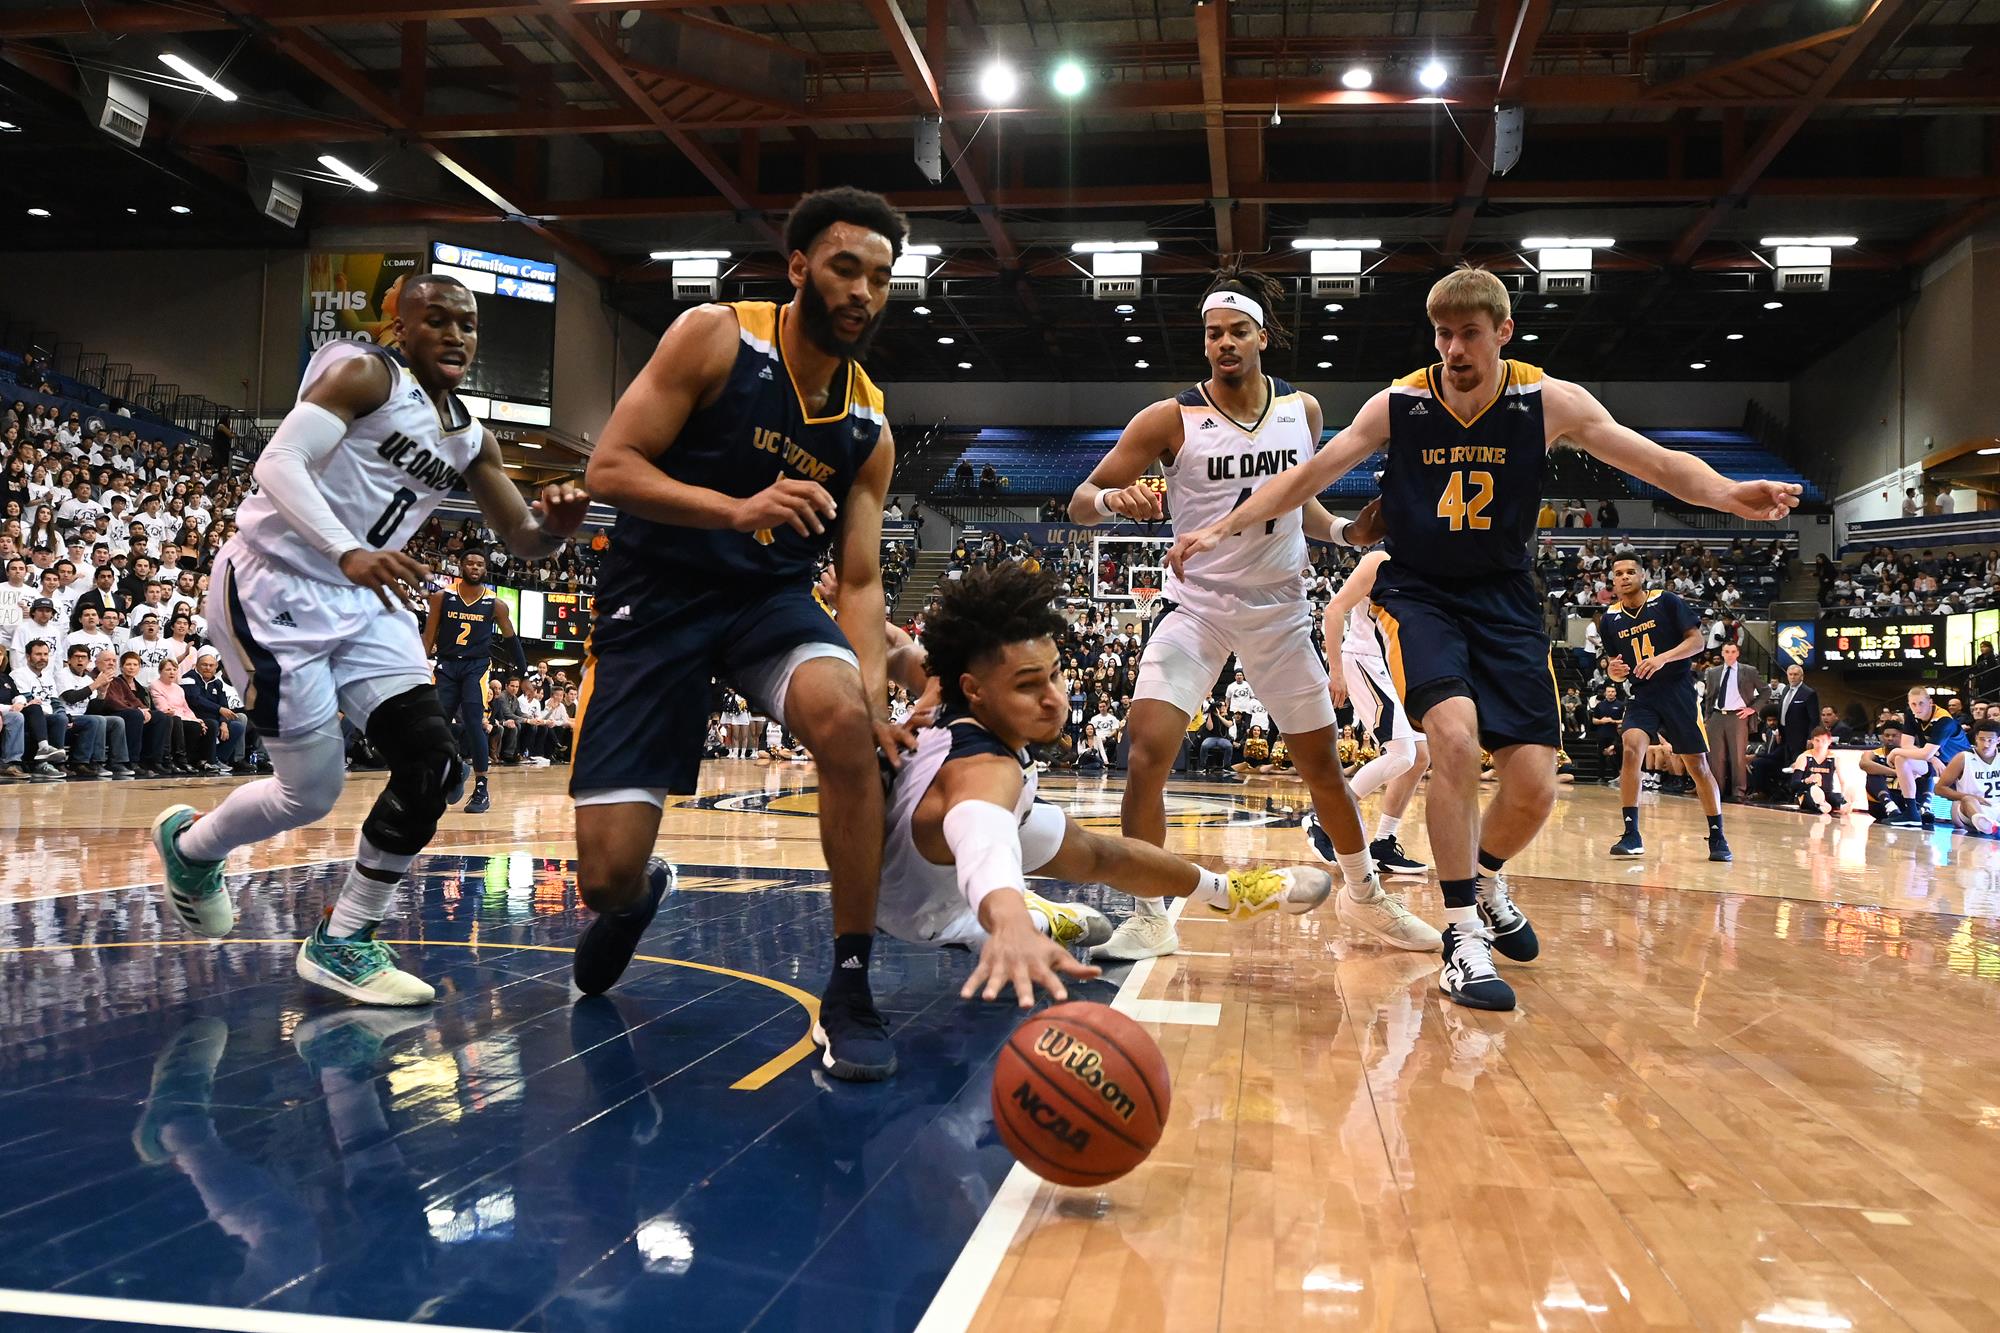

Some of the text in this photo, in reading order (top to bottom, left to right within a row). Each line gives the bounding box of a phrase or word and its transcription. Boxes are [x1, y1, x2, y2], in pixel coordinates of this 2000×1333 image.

[460, 252, 519, 275] Hamilton
[520, 265, 556, 282] Court
[311, 290, 367, 310] THIS
[313, 311, 336, 330] IS
[378, 430, 418, 468] UC
[754, 426, 782, 453] UC
[1207, 449, 1298, 480] UC DAVIS
[1422, 446, 1507, 465] UC IRVINE
[1437, 470, 1494, 531] 42
[366, 486, 417, 549] 0
[1047, 529, 1066, 543] UC
[447, 611, 485, 622] UC IRVINE
[558, 605, 567, 619] 6
[456, 622, 471, 646] 2
[1618, 620, 1656, 639] UC IRVINE
[1631, 633, 1655, 665] 14
[1838, 637, 1850, 650] 6
[1860, 636, 1901, 650] 15:23
[1913, 635, 1931, 649] 10
[1847, 650, 1856, 659] 4
[1858, 650, 1896, 660] HALF 1
[1928, 648, 1937, 658] 4
[1974, 771, 1985, 780] UC
[1034, 1026, 1138, 1123] Wilson
[1012, 1079, 1092, 1154] NCAA
